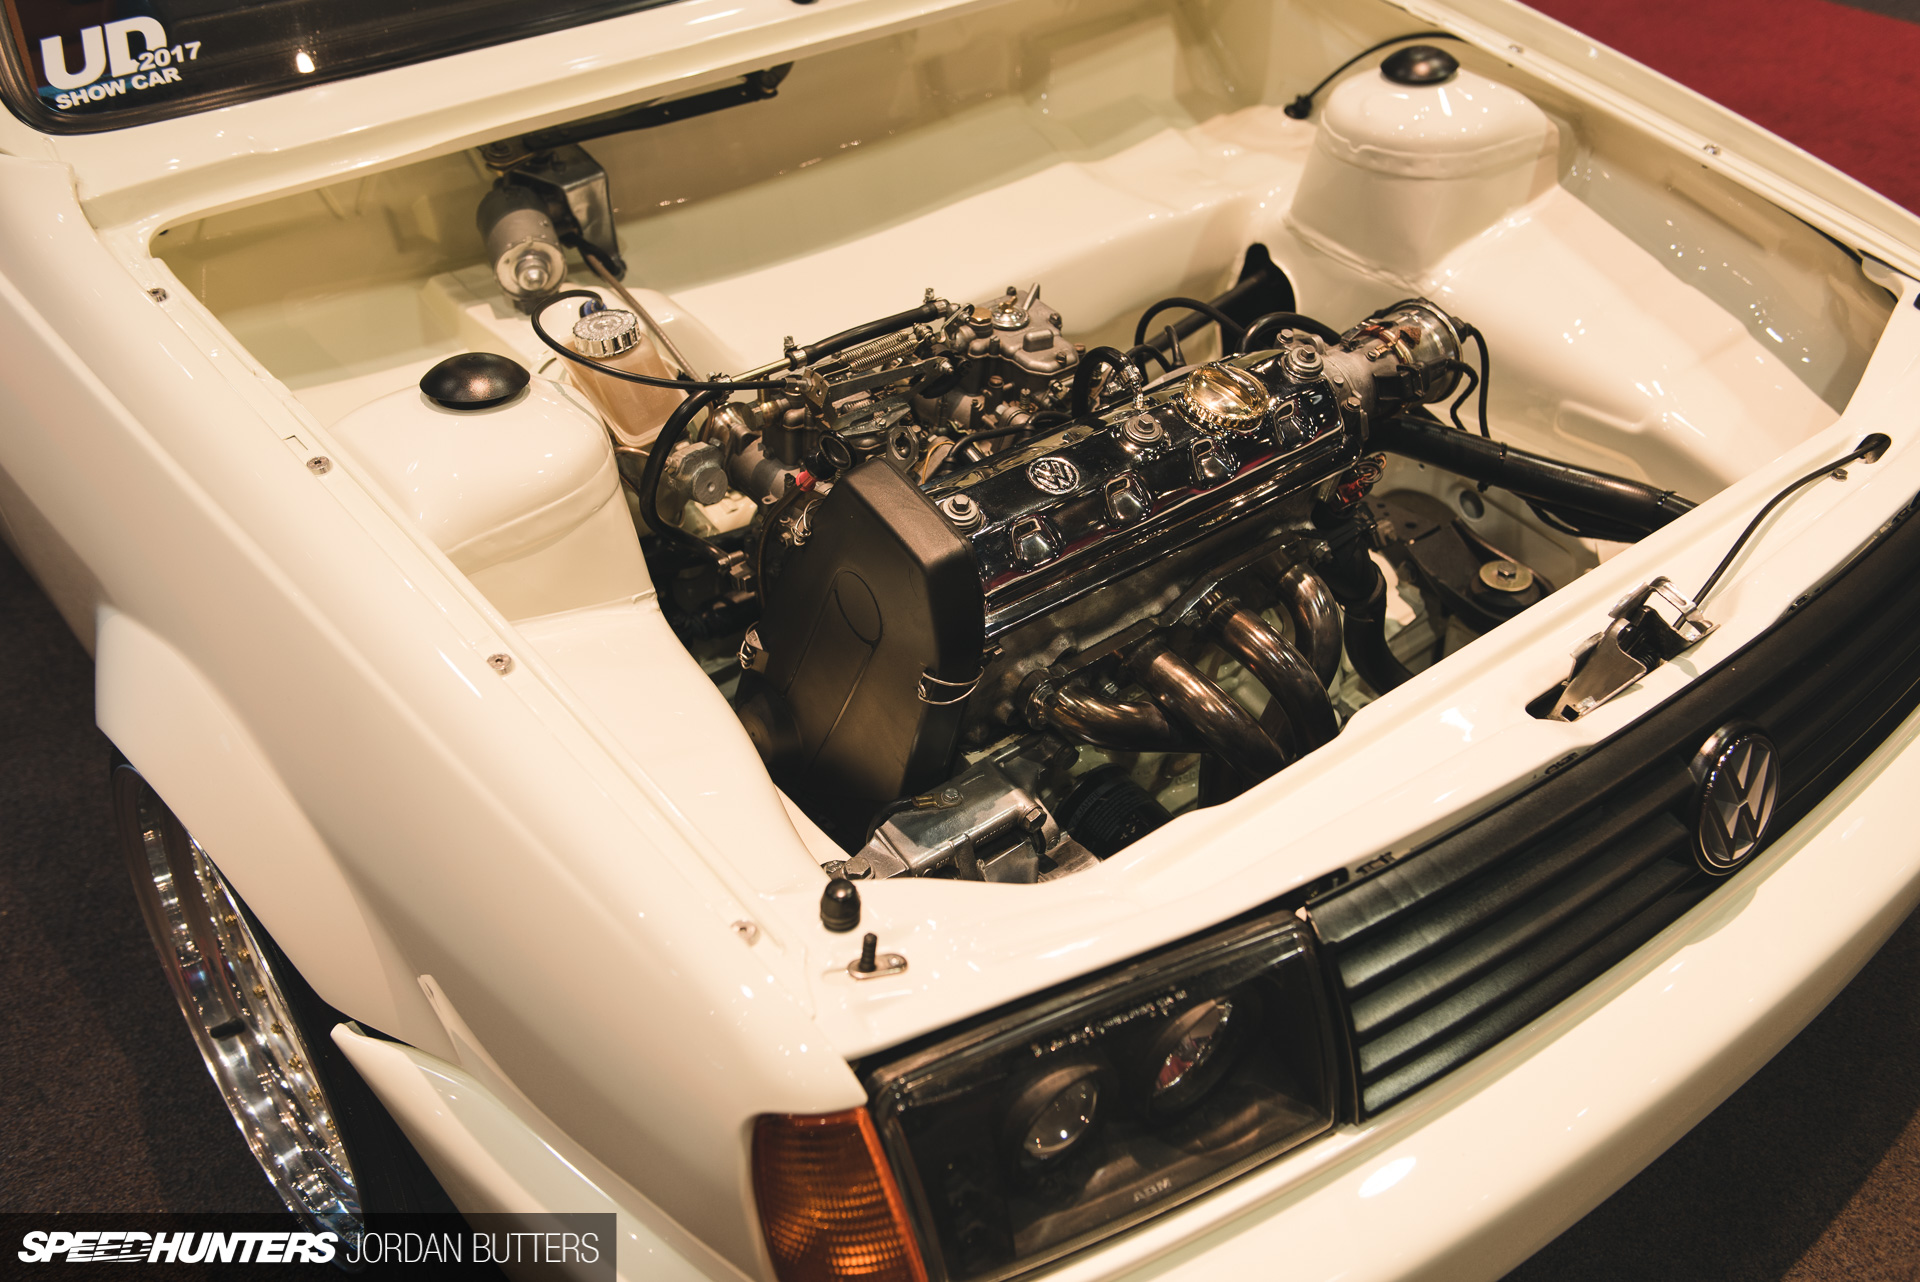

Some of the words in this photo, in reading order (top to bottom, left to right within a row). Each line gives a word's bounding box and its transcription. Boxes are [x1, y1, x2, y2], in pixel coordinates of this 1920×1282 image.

[40, 16, 168, 90] UD
[138, 41, 202, 71] 2017
[55, 79, 126, 110] SHOW
[131, 67, 182, 91] CAR
